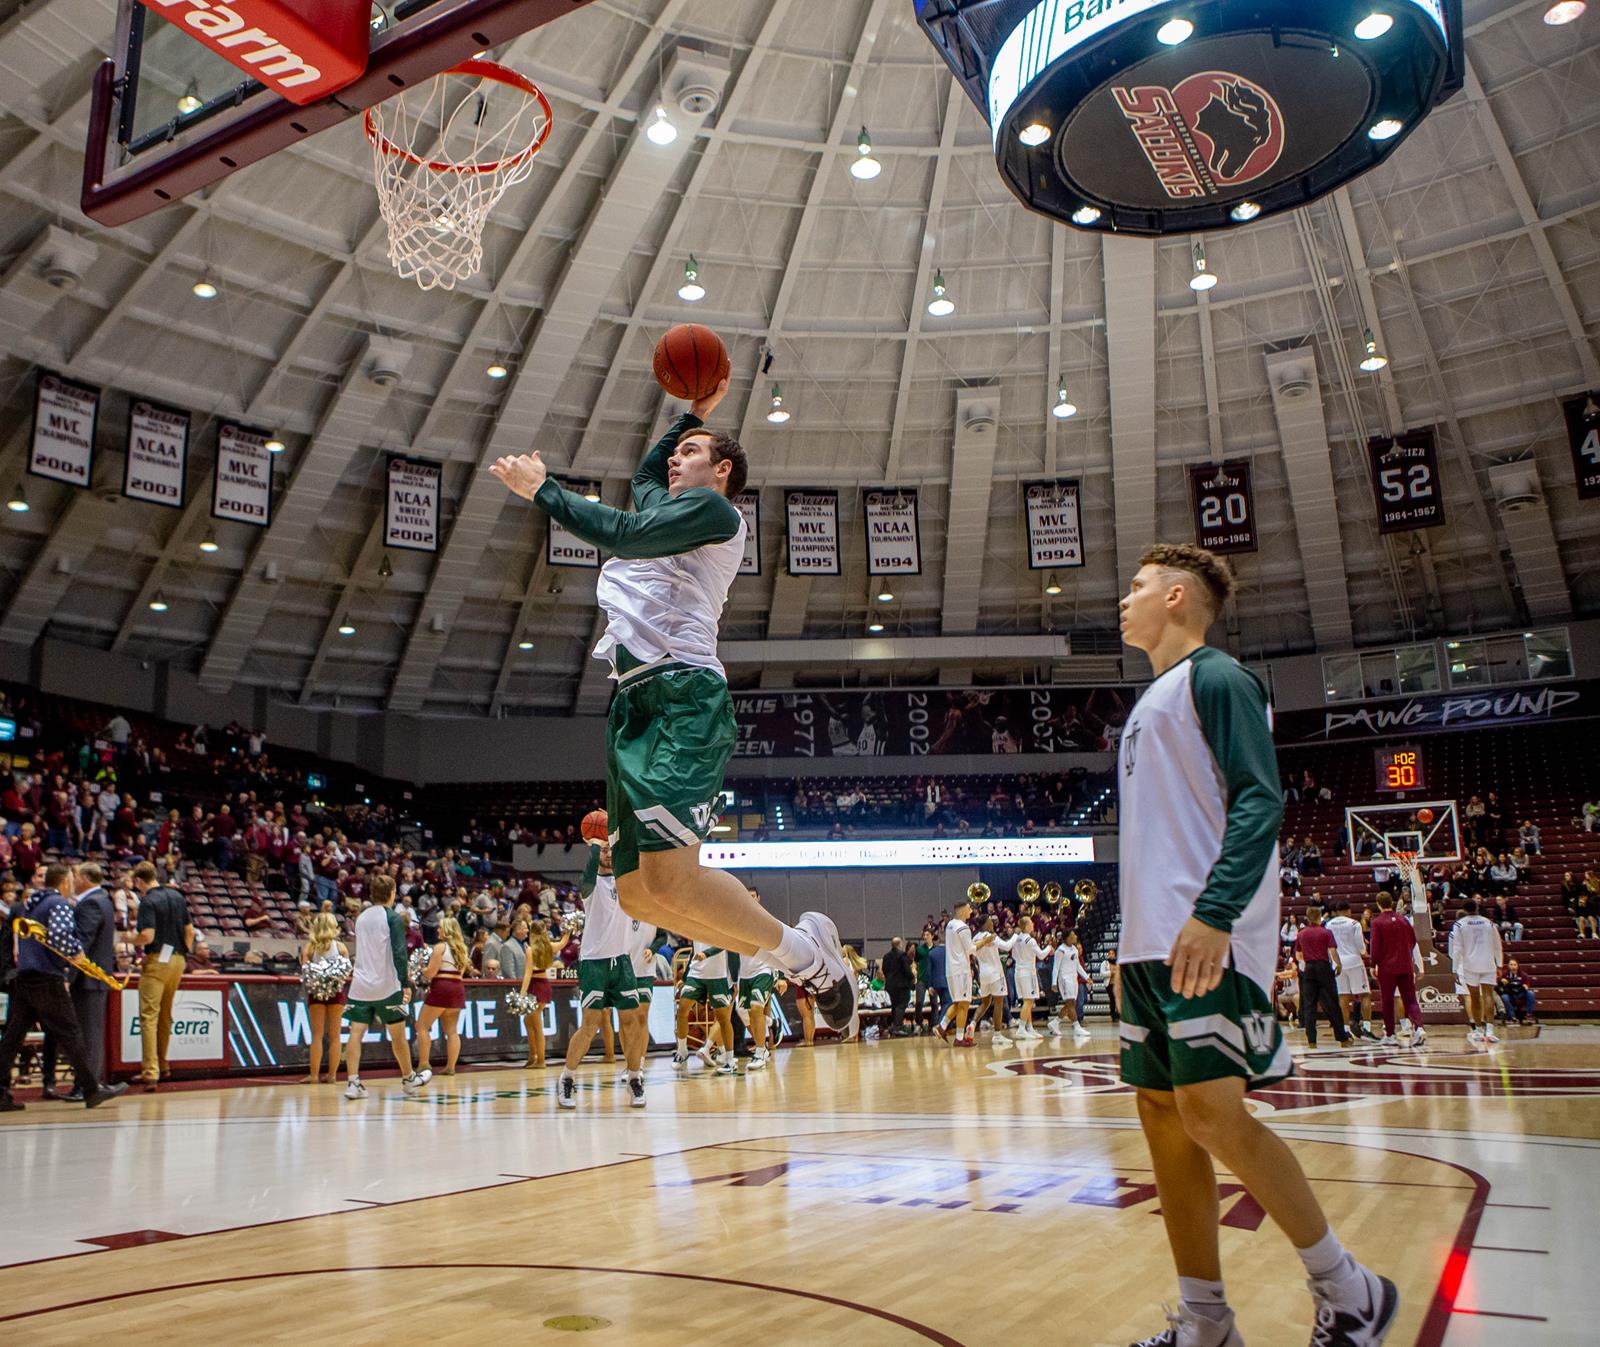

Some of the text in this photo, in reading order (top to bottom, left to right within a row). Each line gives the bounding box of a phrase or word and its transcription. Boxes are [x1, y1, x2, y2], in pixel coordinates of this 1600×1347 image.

[152, 0, 321, 88] arm
[1111, 86, 1206, 198] SALUKIS
[49, 413, 80, 435] MVC
[136, 437, 177, 458] NCAA
[36, 453, 85, 476] 2004
[228, 460, 259, 478] MVC
[131, 478, 178, 497] 2003
[1380, 464, 1432, 502] 52
[395, 490, 431, 508] NCAA
[220, 499, 265, 517] 2003
[400, 506, 426, 516] SWEET
[1200, 493, 1246, 529] 20
[1384, 506, 1436, 522] 1964-1967
[395, 515, 430, 527] SIXTEEN
[799, 522, 826, 534] MVC
[873, 522, 910, 534] NCAA
[1039, 514, 1068, 527] MVC
[390, 528, 433, 543] 2002
[871, 535, 914, 543] TOURNAMENT
[1032, 528, 1077, 537] TOURNAMENT
[1032, 536, 1079, 546] CHAMPIONS
[552, 546, 595, 559] 2002
[1036, 549, 1076, 561] 1994
[795, 557, 833, 567] 1995
[874, 557, 913, 568] 1994
[1304, 686, 1580, 739] DAWG POUND
[794, 694, 815, 757] 1977
[907, 693, 930, 755] 2002
[1030, 690, 1054, 753] 2007
[1394, 752, 1416, 765] 1:02
[1388, 766, 1414, 786] 30
[178, 1037, 209, 1046] CENTER
